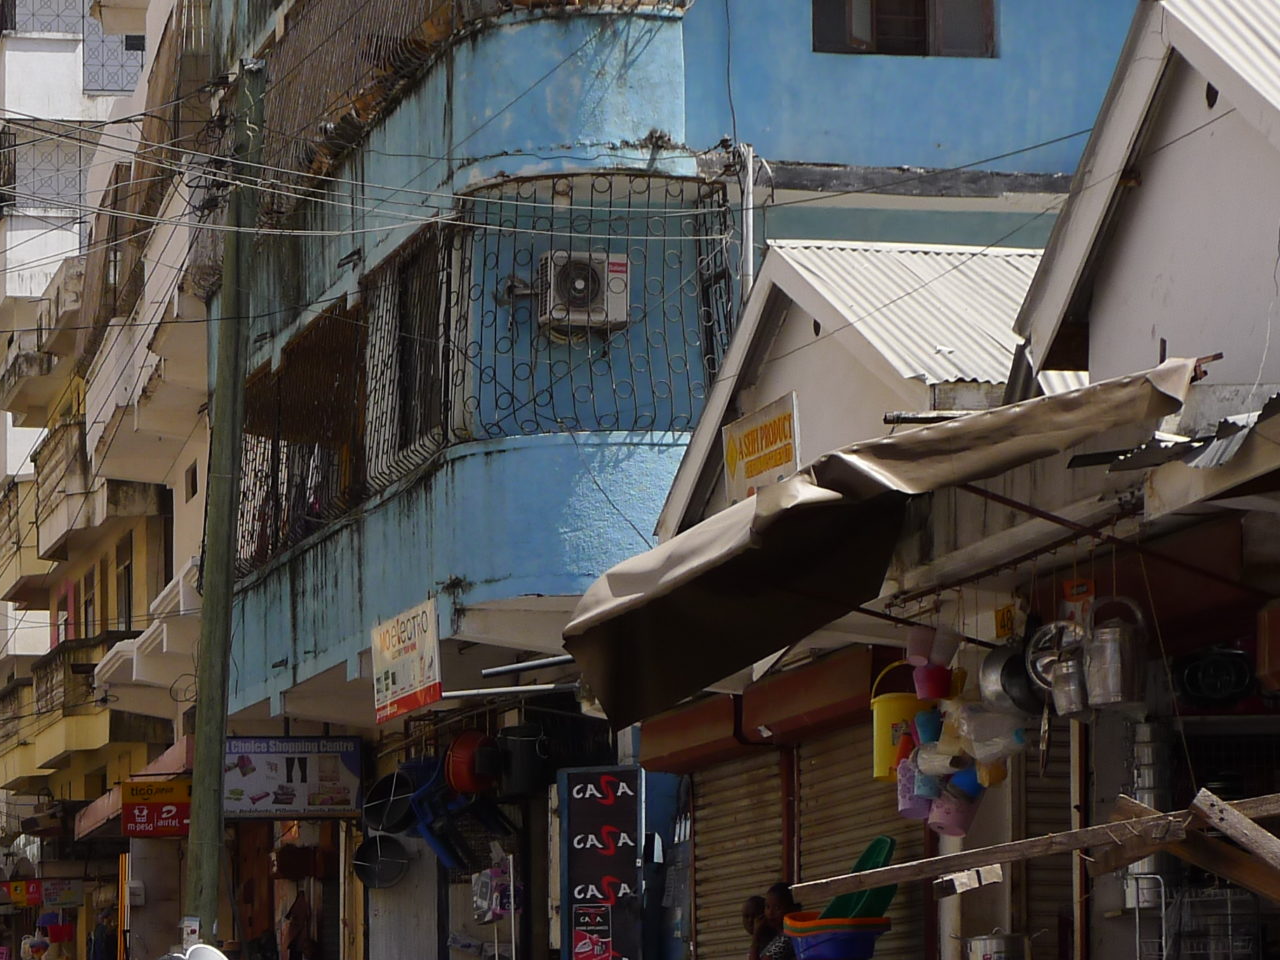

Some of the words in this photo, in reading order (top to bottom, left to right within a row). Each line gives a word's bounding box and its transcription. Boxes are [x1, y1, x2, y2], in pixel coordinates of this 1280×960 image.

[760, 412, 792, 451] PRODUCT
[231, 741, 267, 752] Choice
[268, 740, 318, 753] Shopping
[319, 741, 354, 752] Centre
[572, 774, 635, 806] CASA
[572, 824, 636, 856] CASA
[573, 875, 638, 906] CASA
